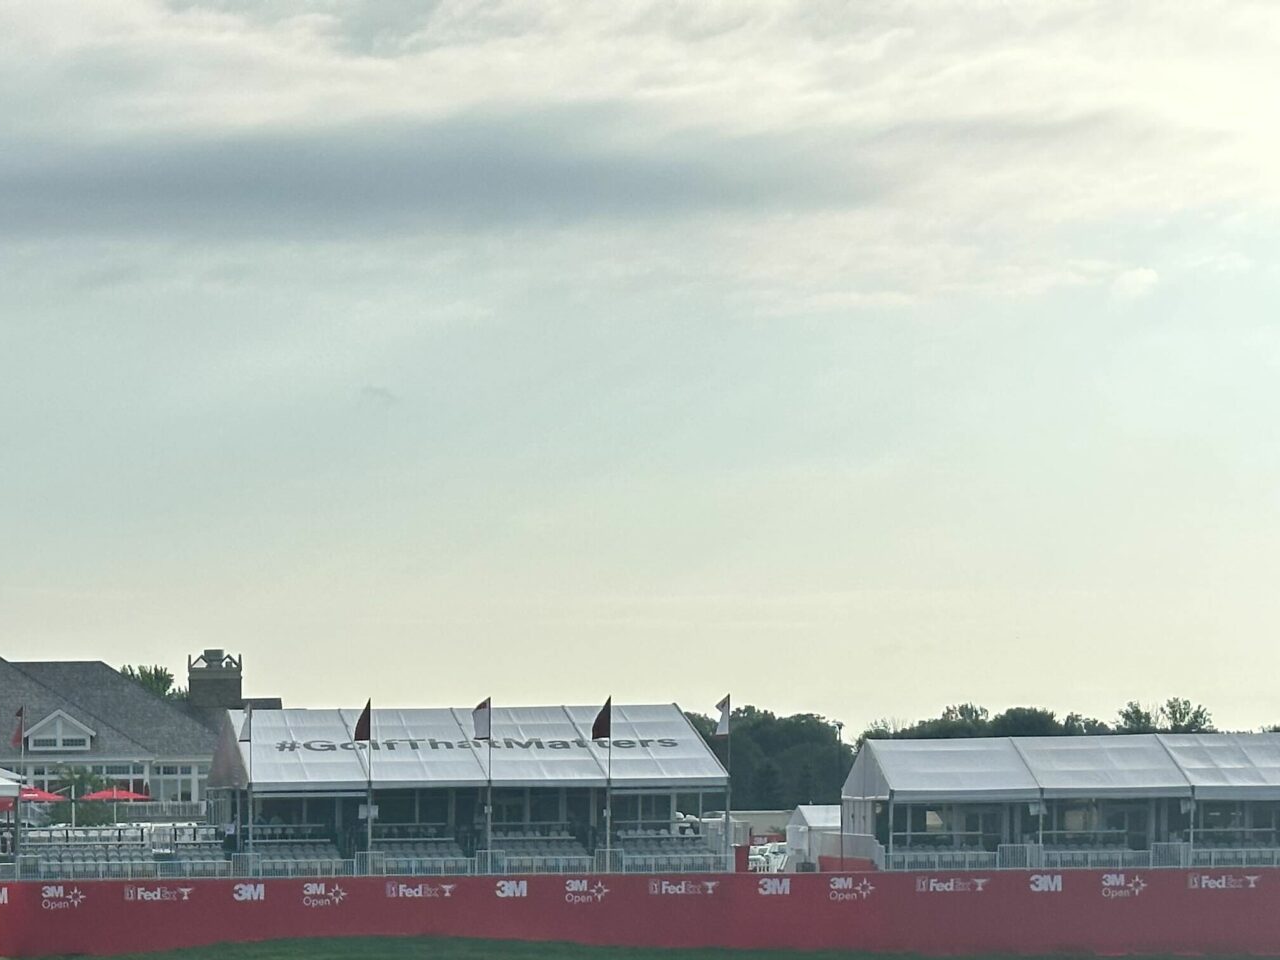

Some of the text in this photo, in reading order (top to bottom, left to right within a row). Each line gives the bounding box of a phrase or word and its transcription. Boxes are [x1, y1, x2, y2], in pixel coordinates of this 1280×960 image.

[565, 879, 588, 892] 3M
[829, 877, 852, 889] 3M
[1030, 874, 1063, 892] 3M
[1101, 874, 1125, 886] 3M
[41, 886, 64, 898] 3M
[233, 883, 265, 901] 3M
[303, 883, 325, 896] 3M
[496, 880, 528, 897] 3M
[758, 878, 790, 895] 3M
[1101, 887, 1130, 898] Open
[565, 893, 593, 904] Open
[829, 890, 858, 901] Open
[41, 900, 69, 910] Open
[303, 896, 331, 908] Open
